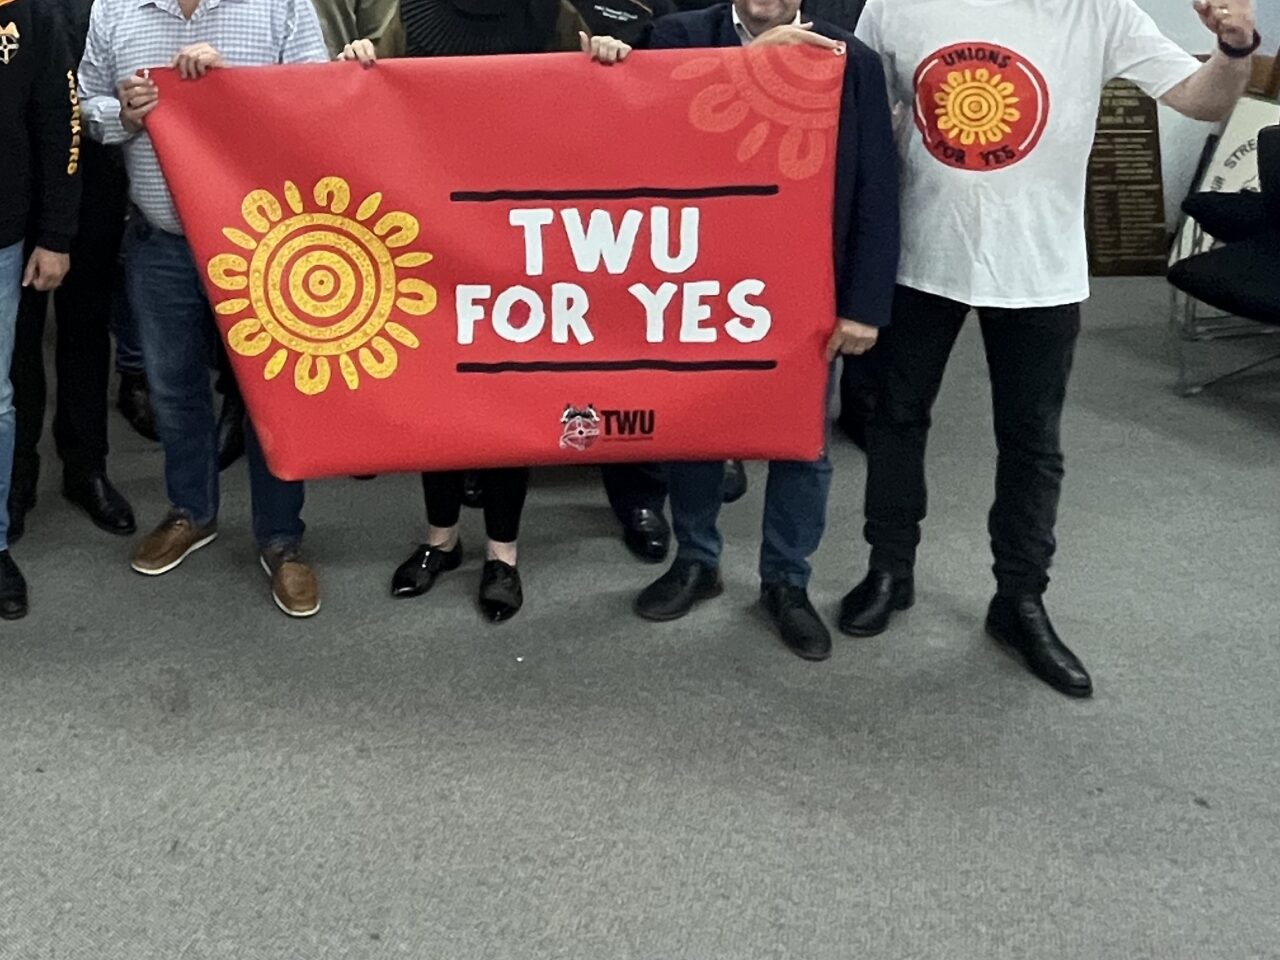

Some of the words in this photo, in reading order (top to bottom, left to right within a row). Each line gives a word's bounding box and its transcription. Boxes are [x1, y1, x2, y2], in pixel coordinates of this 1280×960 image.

[942, 47, 1011, 68] UNIONS
[932, 140, 966, 164] FOR
[979, 145, 1016, 166] YES
[509, 206, 699, 276] TWU
[455, 282, 595, 346] FOR
[628, 279, 772, 343] YES
[600, 410, 655, 436] TWU
